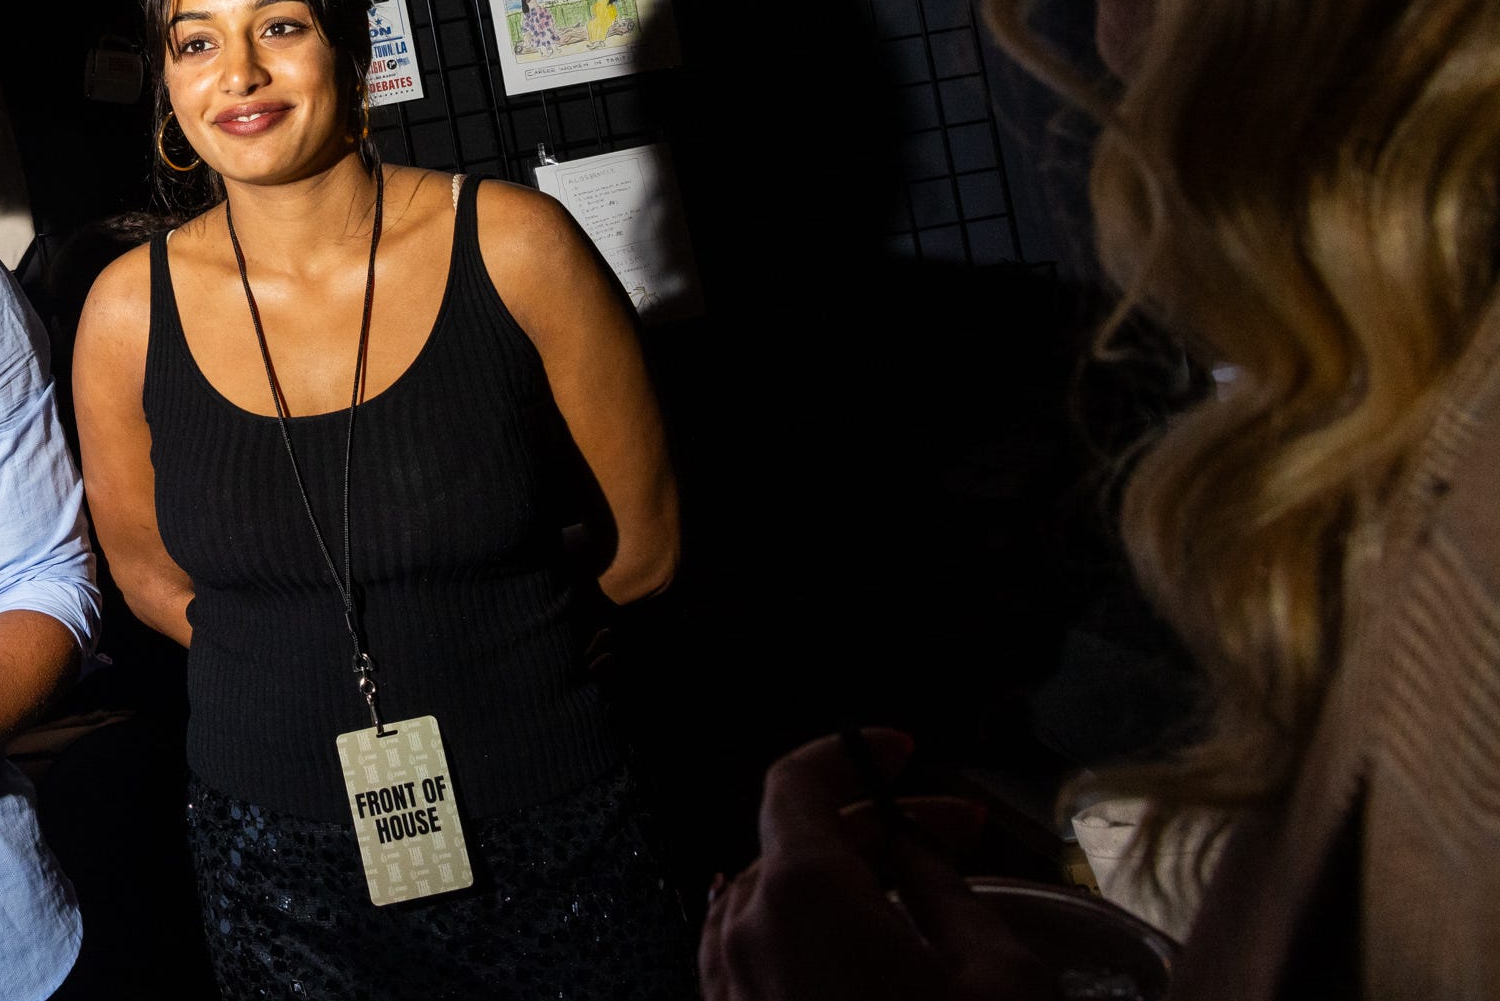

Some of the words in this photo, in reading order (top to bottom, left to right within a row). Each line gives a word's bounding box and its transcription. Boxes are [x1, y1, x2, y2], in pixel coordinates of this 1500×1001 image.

[395, 41, 408, 54] LA
[355, 782, 418, 819] FRONT
[422, 775, 447, 804] OF
[375, 807, 442, 844] HOUSE
